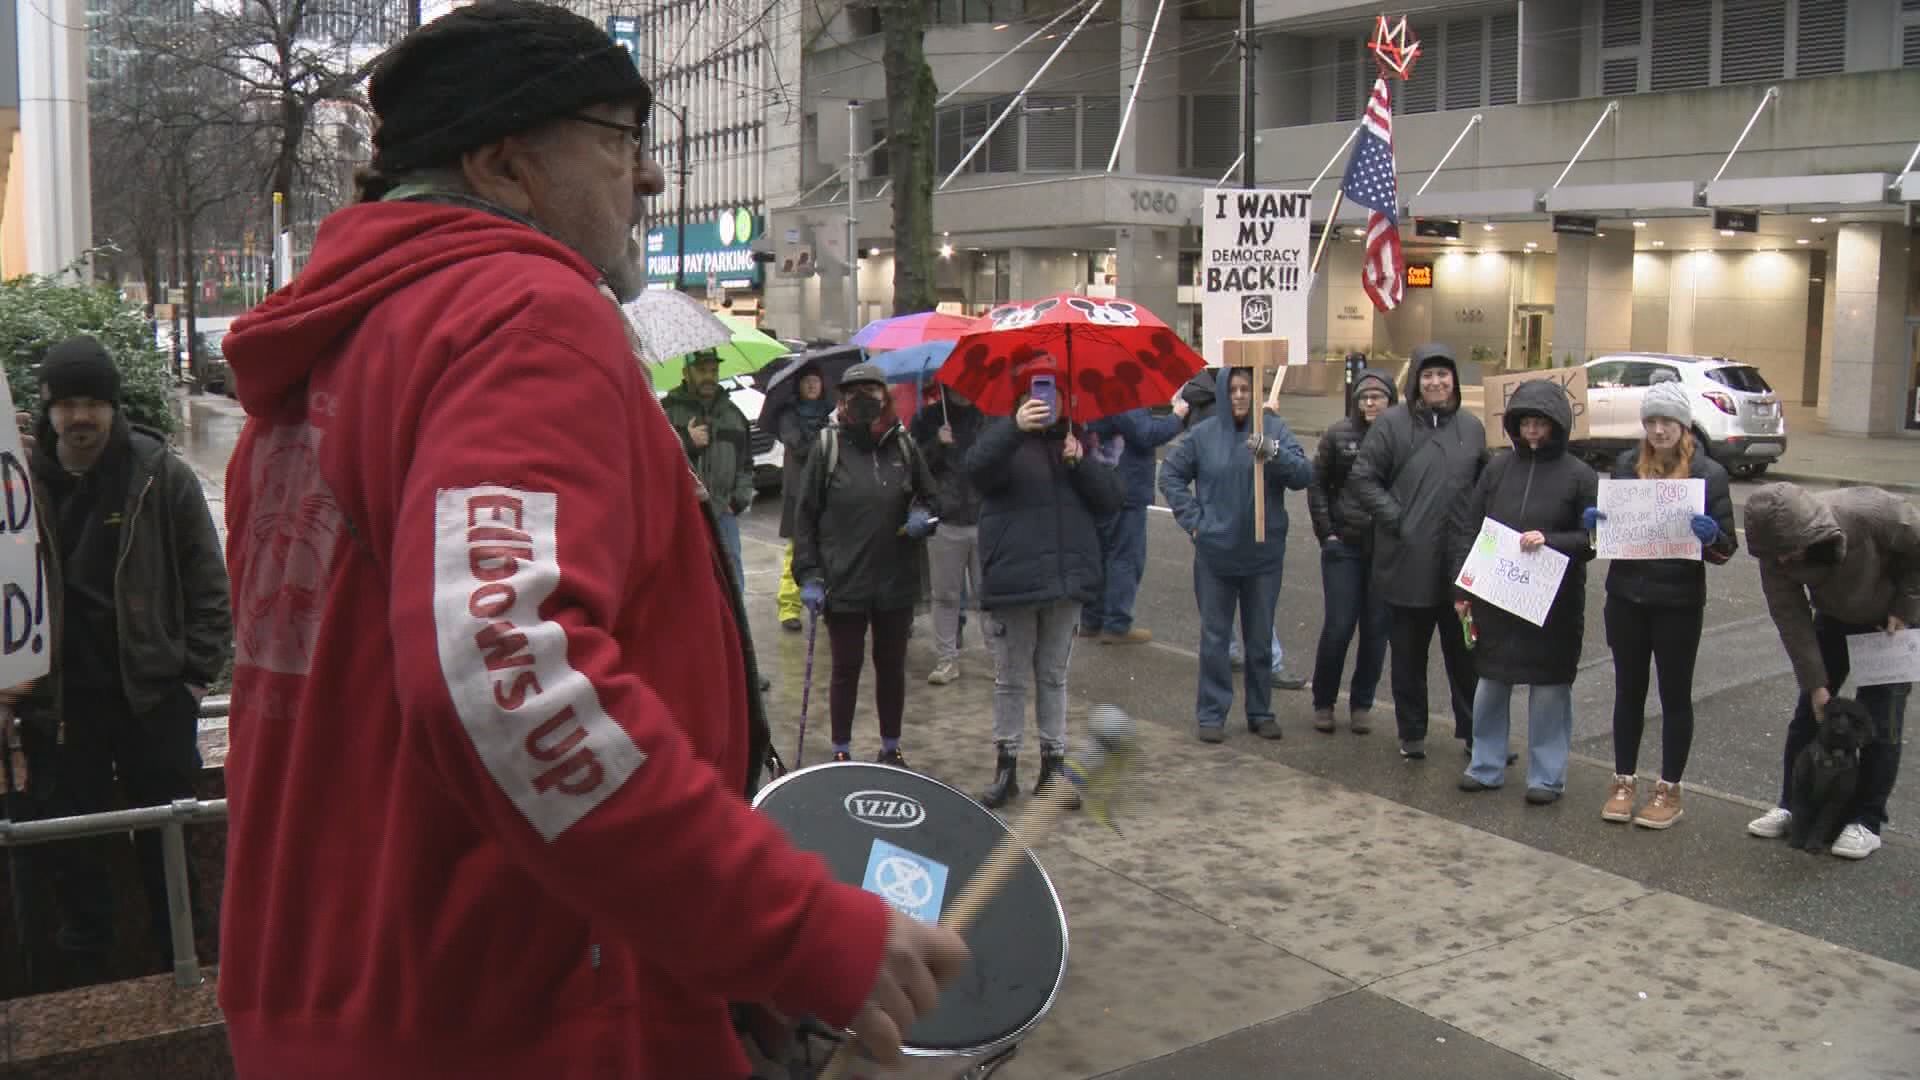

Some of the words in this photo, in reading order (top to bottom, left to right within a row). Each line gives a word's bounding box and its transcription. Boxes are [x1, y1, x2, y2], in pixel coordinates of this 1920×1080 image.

[1215, 194, 1228, 219] I
[1237, 193, 1312, 219] WANT
[1237, 222, 1275, 246] MY
[683, 252, 704, 273] PAY
[704, 250, 754, 272] PARKING
[1212, 249, 1300, 262] DEMOCRACY
[1207, 267, 1299, 292] BACK!!!
